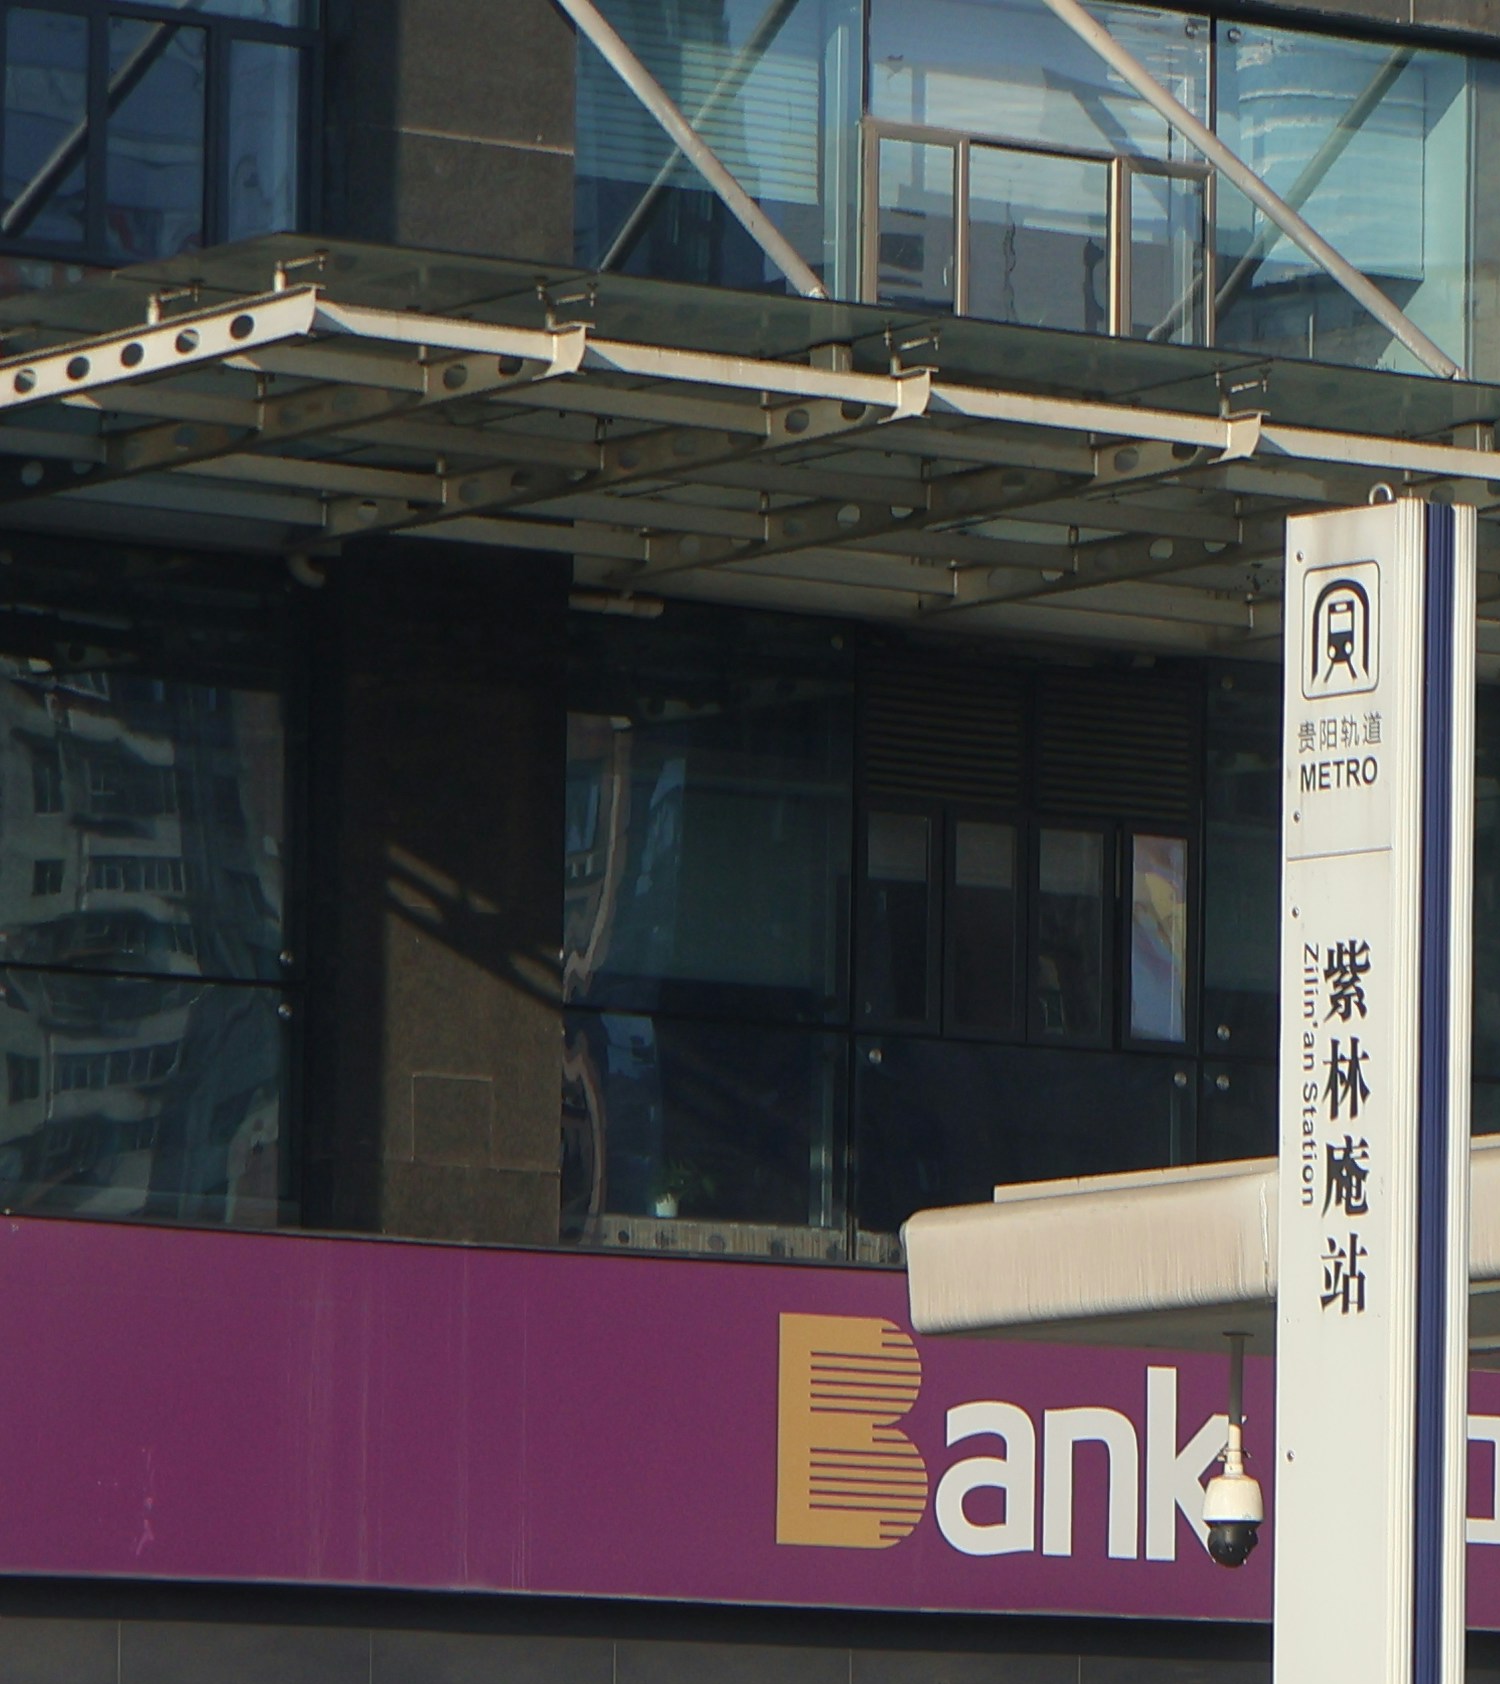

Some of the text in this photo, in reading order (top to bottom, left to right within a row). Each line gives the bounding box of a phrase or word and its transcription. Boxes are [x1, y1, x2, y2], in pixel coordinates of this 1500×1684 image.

[1298, 711, 1382, 753] 贵阳轨道
[1300, 756, 1378, 792] METRO
[1301, 942, 1319, 1206] Zilin'an Station
[1321, 939, 1371, 1315] 紫林庵站
[776, 1312, 1250, 1563] Bank
